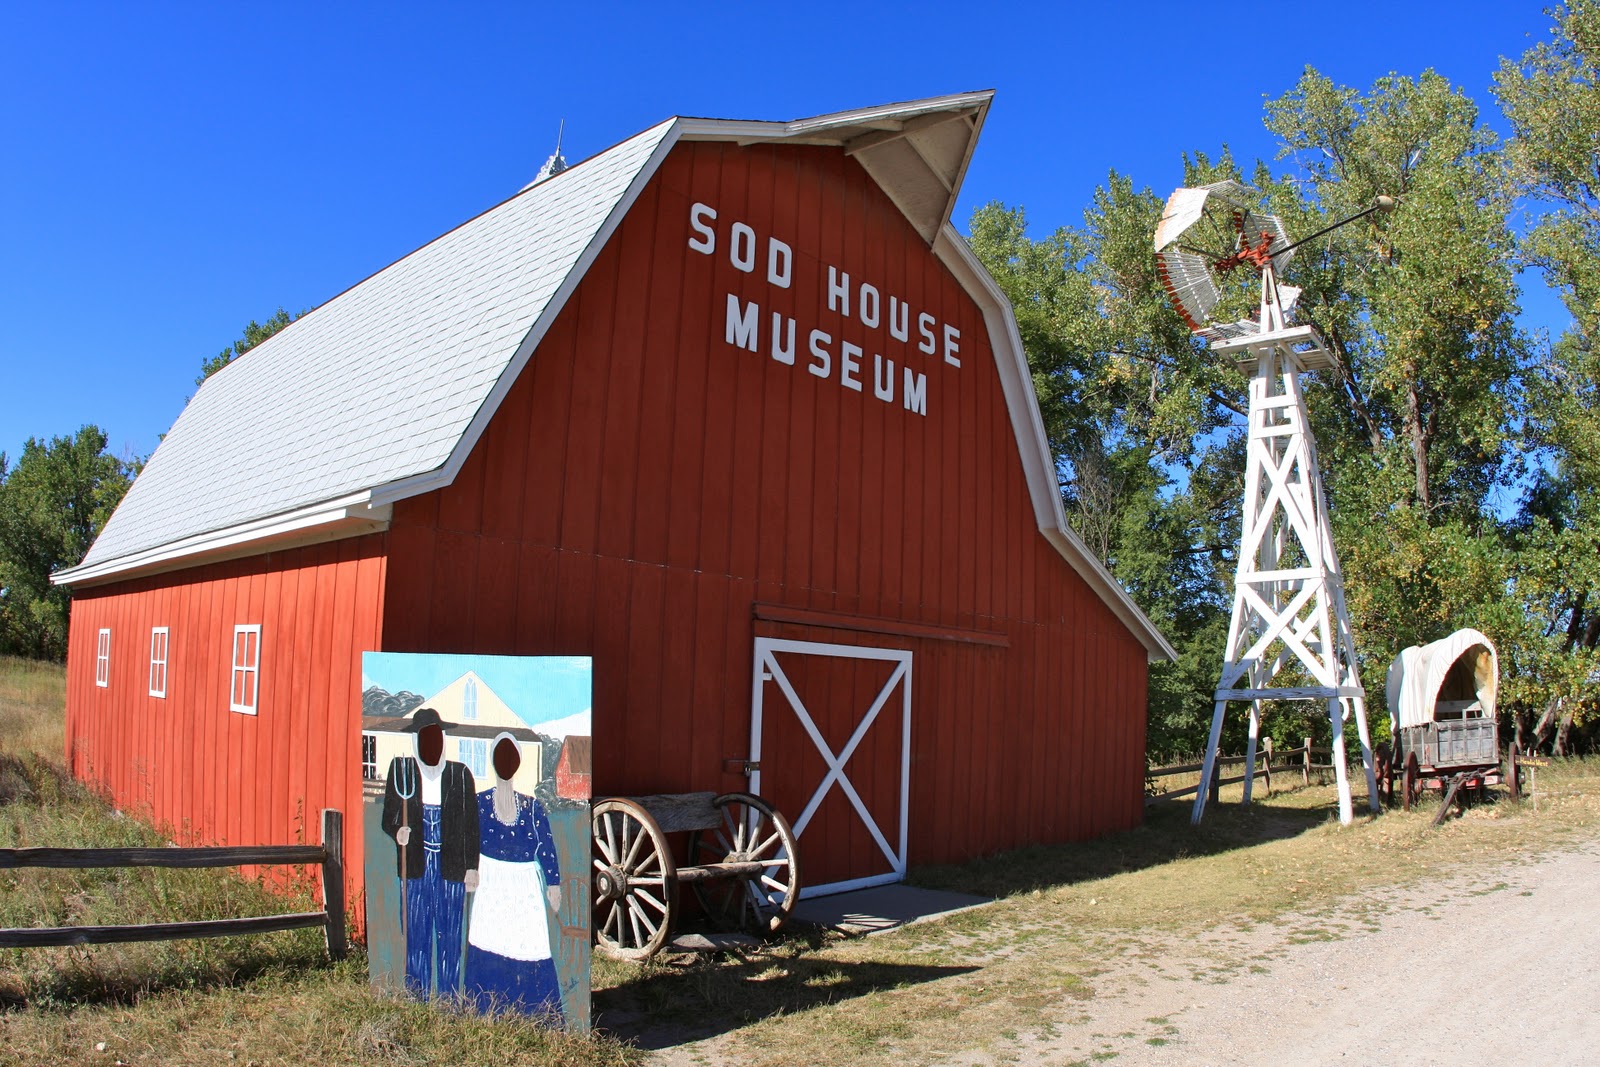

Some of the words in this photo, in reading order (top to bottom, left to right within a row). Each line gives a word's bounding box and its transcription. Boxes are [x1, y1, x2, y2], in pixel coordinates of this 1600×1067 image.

[688, 202, 793, 289] SOD
[828, 265, 961, 368] HOUSE
[725, 293, 927, 416] MUSEUM
